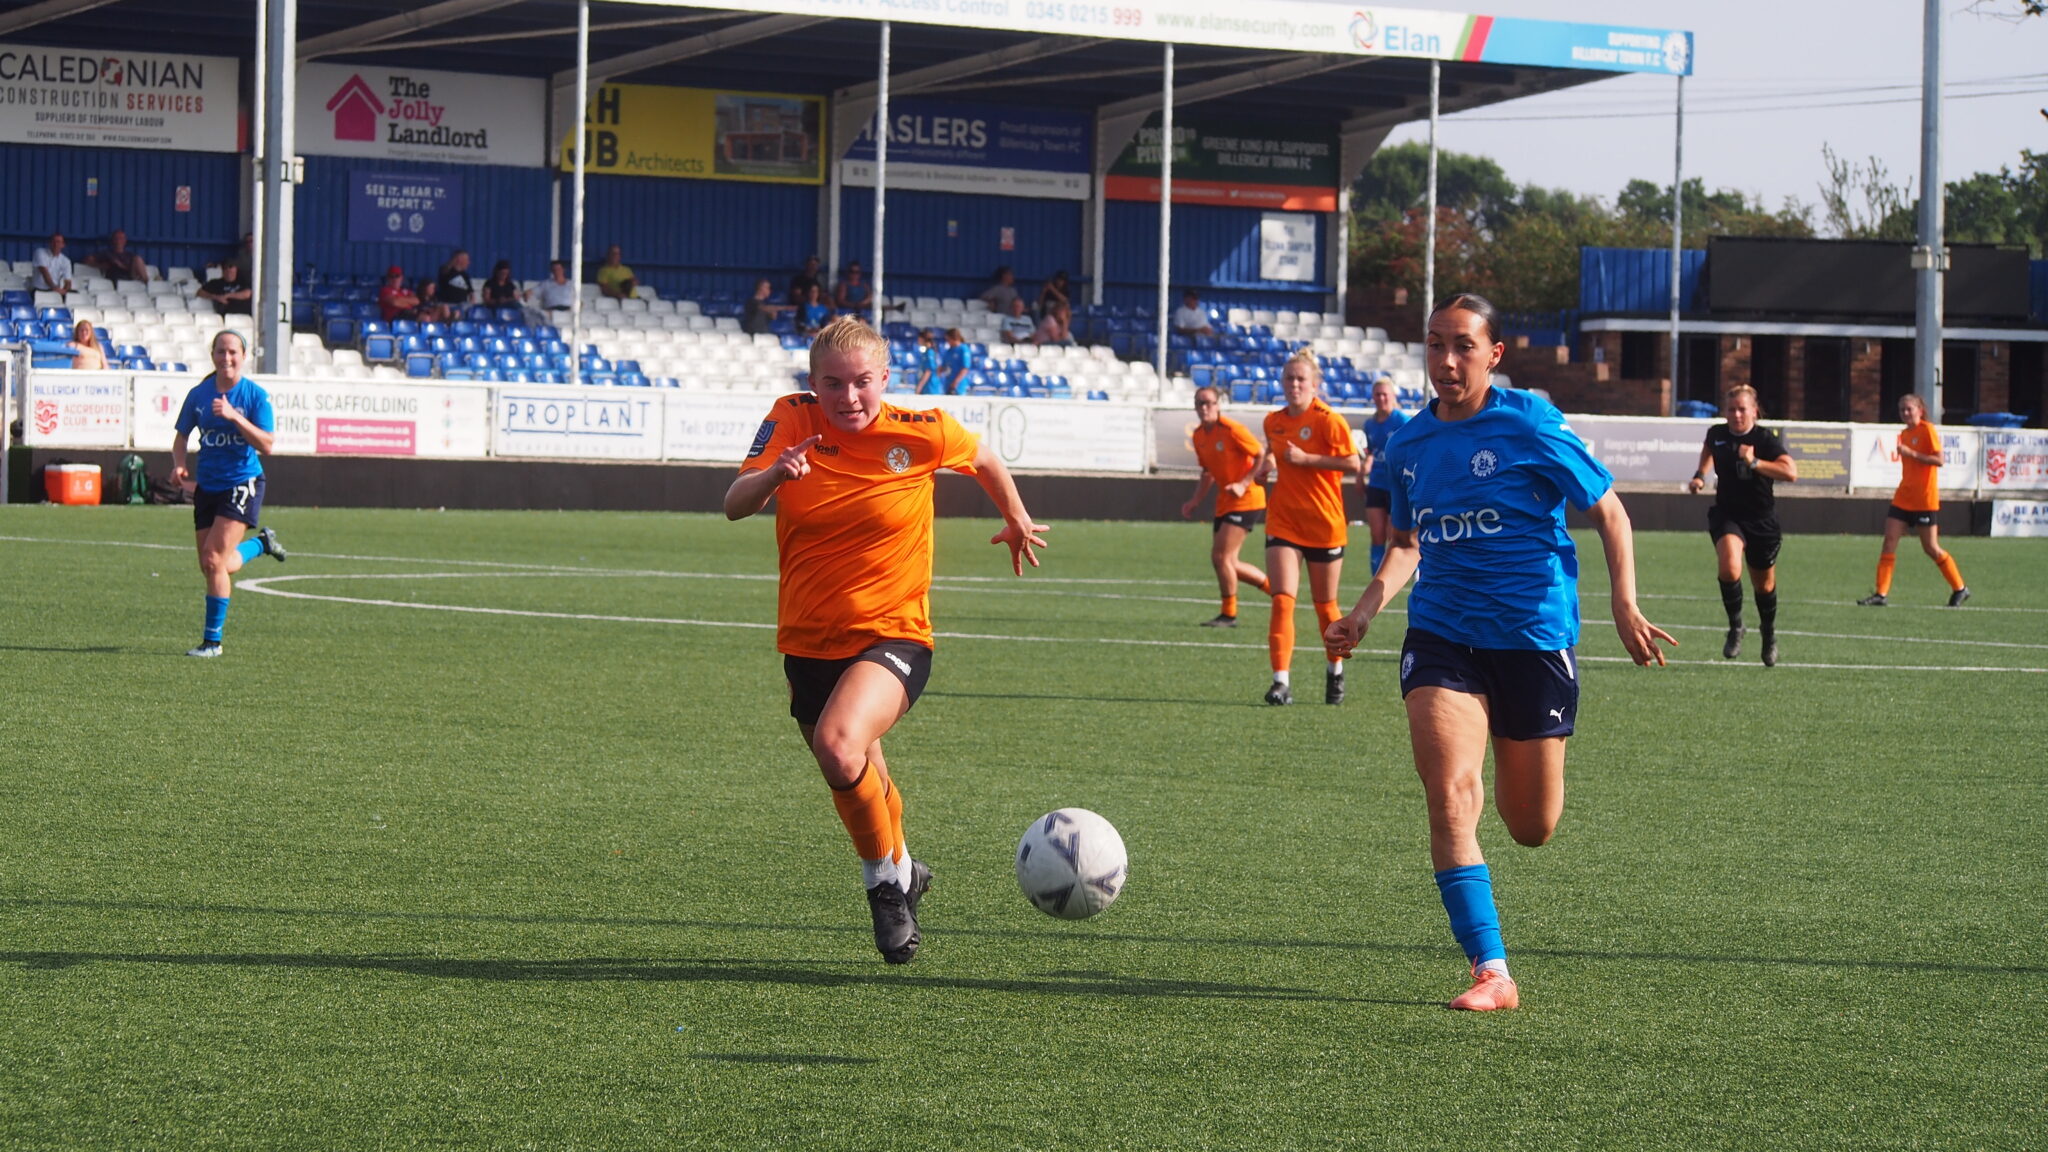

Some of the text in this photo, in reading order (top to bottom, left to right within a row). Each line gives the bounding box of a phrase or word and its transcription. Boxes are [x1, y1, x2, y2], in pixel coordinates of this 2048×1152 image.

[947, 0, 1009, 17] Control
[1026, 1, 1067, 21] 0345
[1070, 4, 1111, 24] 0215
[1113, 7, 1144, 27] 999
[1155, 12, 1335, 41] www.elansecurity.com
[1384, 25, 1441, 53] Elan
[0, 52, 204, 89] CALEDONIAN
[389, 75, 430, 99] The
[0, 86, 204, 114] CONSTRUCTION SERVICES
[35, 111, 165, 128] SUPPLIERS OF TEMPORARY LABOUR
[388, 100, 445, 127] Jolly
[387, 123, 488, 149] Landlord
[625, 151, 705, 174] Architects
[365, 183, 385, 196] SEE
[402, 185, 431, 198] HEAR
[377, 196, 420, 210] REPORT
[34, 384, 123, 396] BILLERICAY TOWN FC
[64, 403, 122, 415] ACCREDITED
[316, 394, 417, 414] SCAFFOLDING
[63, 416, 88, 427] CLUB
[507, 395, 650, 436] PROPLANT
[963, 407, 984, 424] Ltd
[704, 420, 746, 437] 01277
[1637, 438, 1659, 452] small
[1603, 454, 1650, 467] on the pitch
[2010, 465, 2031, 476] CLUB
[232, 485, 249, 506] 17
[2032, 506, 2039, 515] A
